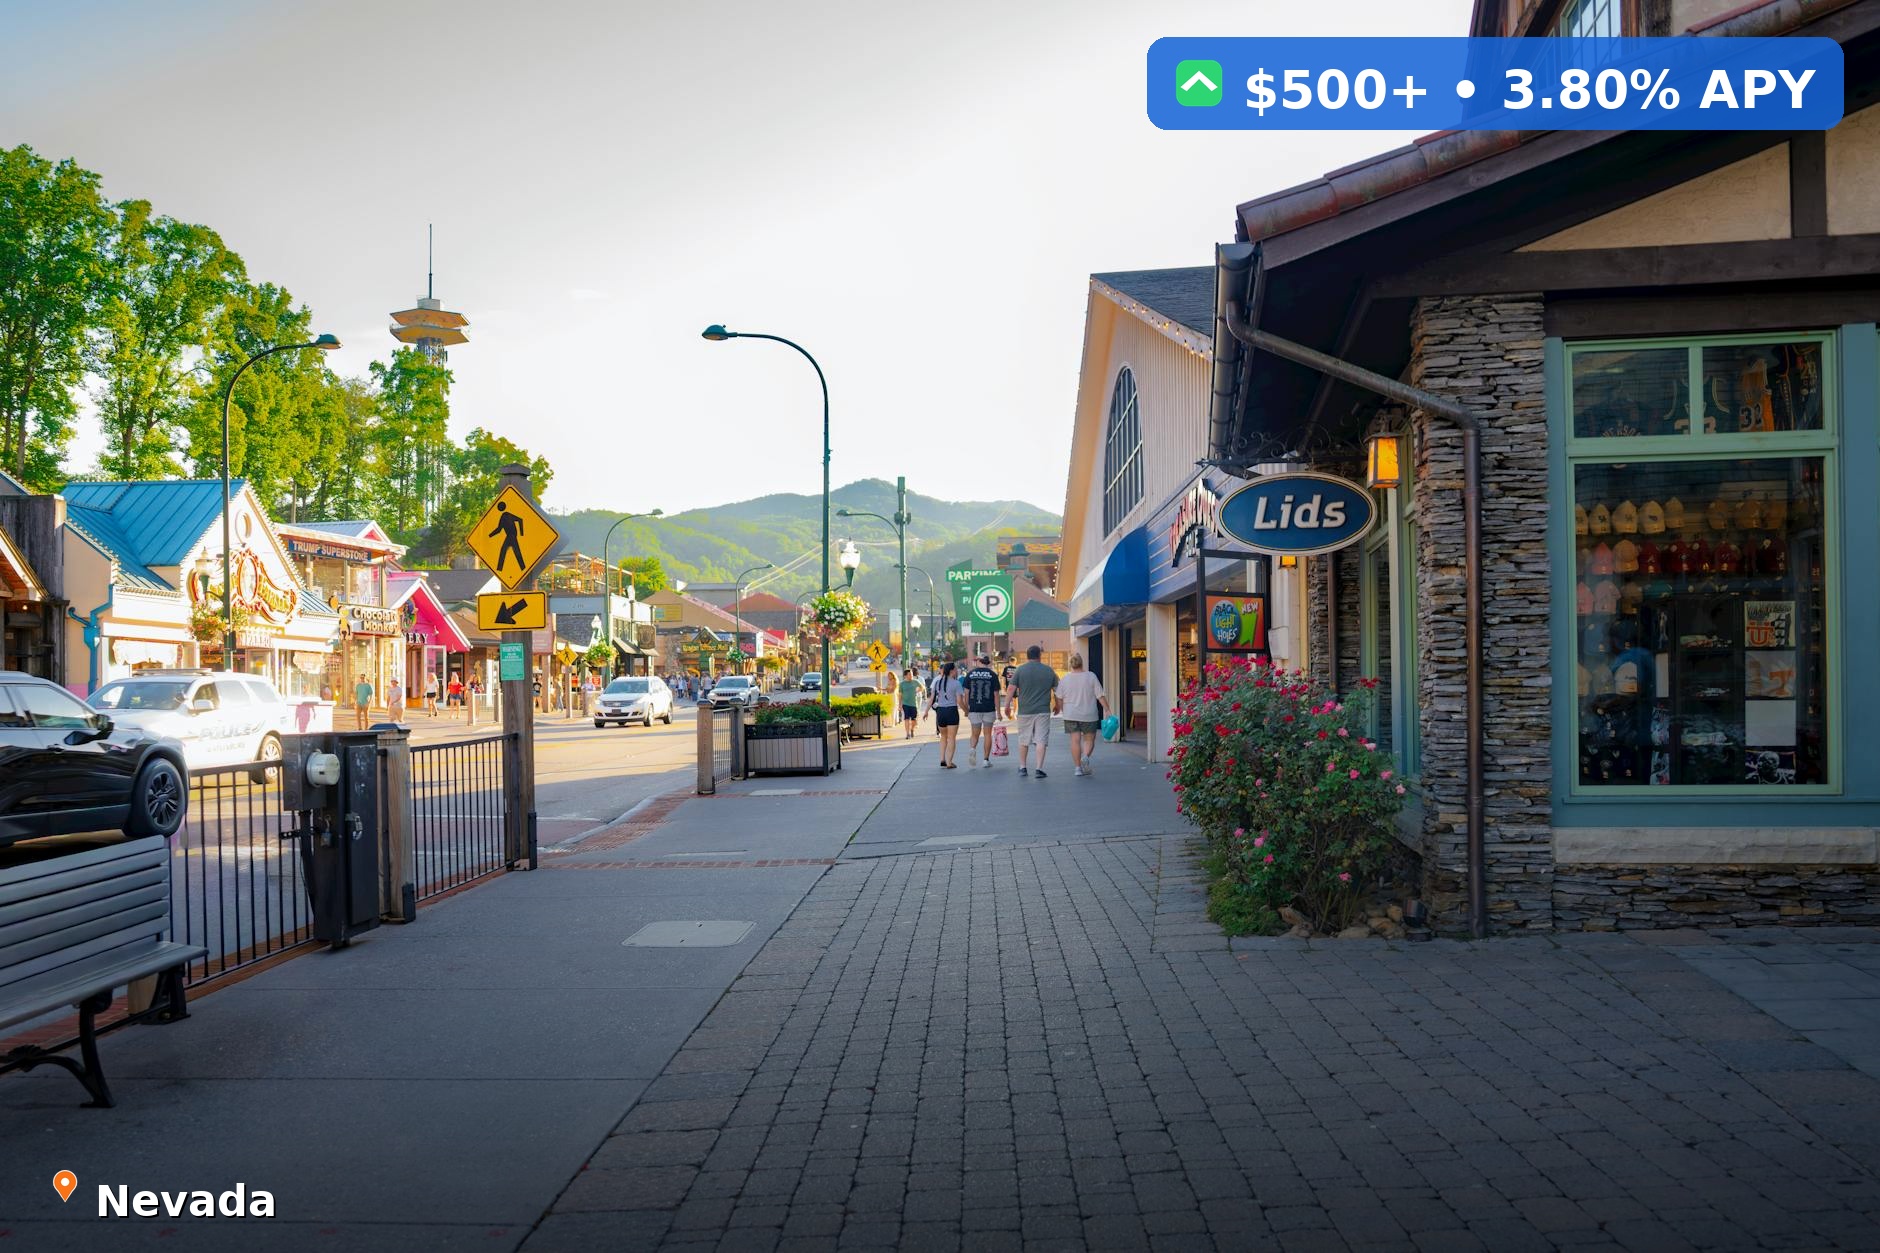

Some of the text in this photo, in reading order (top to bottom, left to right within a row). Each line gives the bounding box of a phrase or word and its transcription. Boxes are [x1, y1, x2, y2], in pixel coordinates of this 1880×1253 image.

[1253, 494, 1347, 530] Lids
[292, 540, 368, 560] TRUMP SUPERSTORE
[985, 595, 1000, 613] P
[1241, 602, 1259, 615] NEW
[352, 608, 397, 620] Chocolate
[1215, 614, 1236, 628] LIGHT
[363, 620, 400, 634] Monkey
[1217, 628, 1238, 643] HOLES
